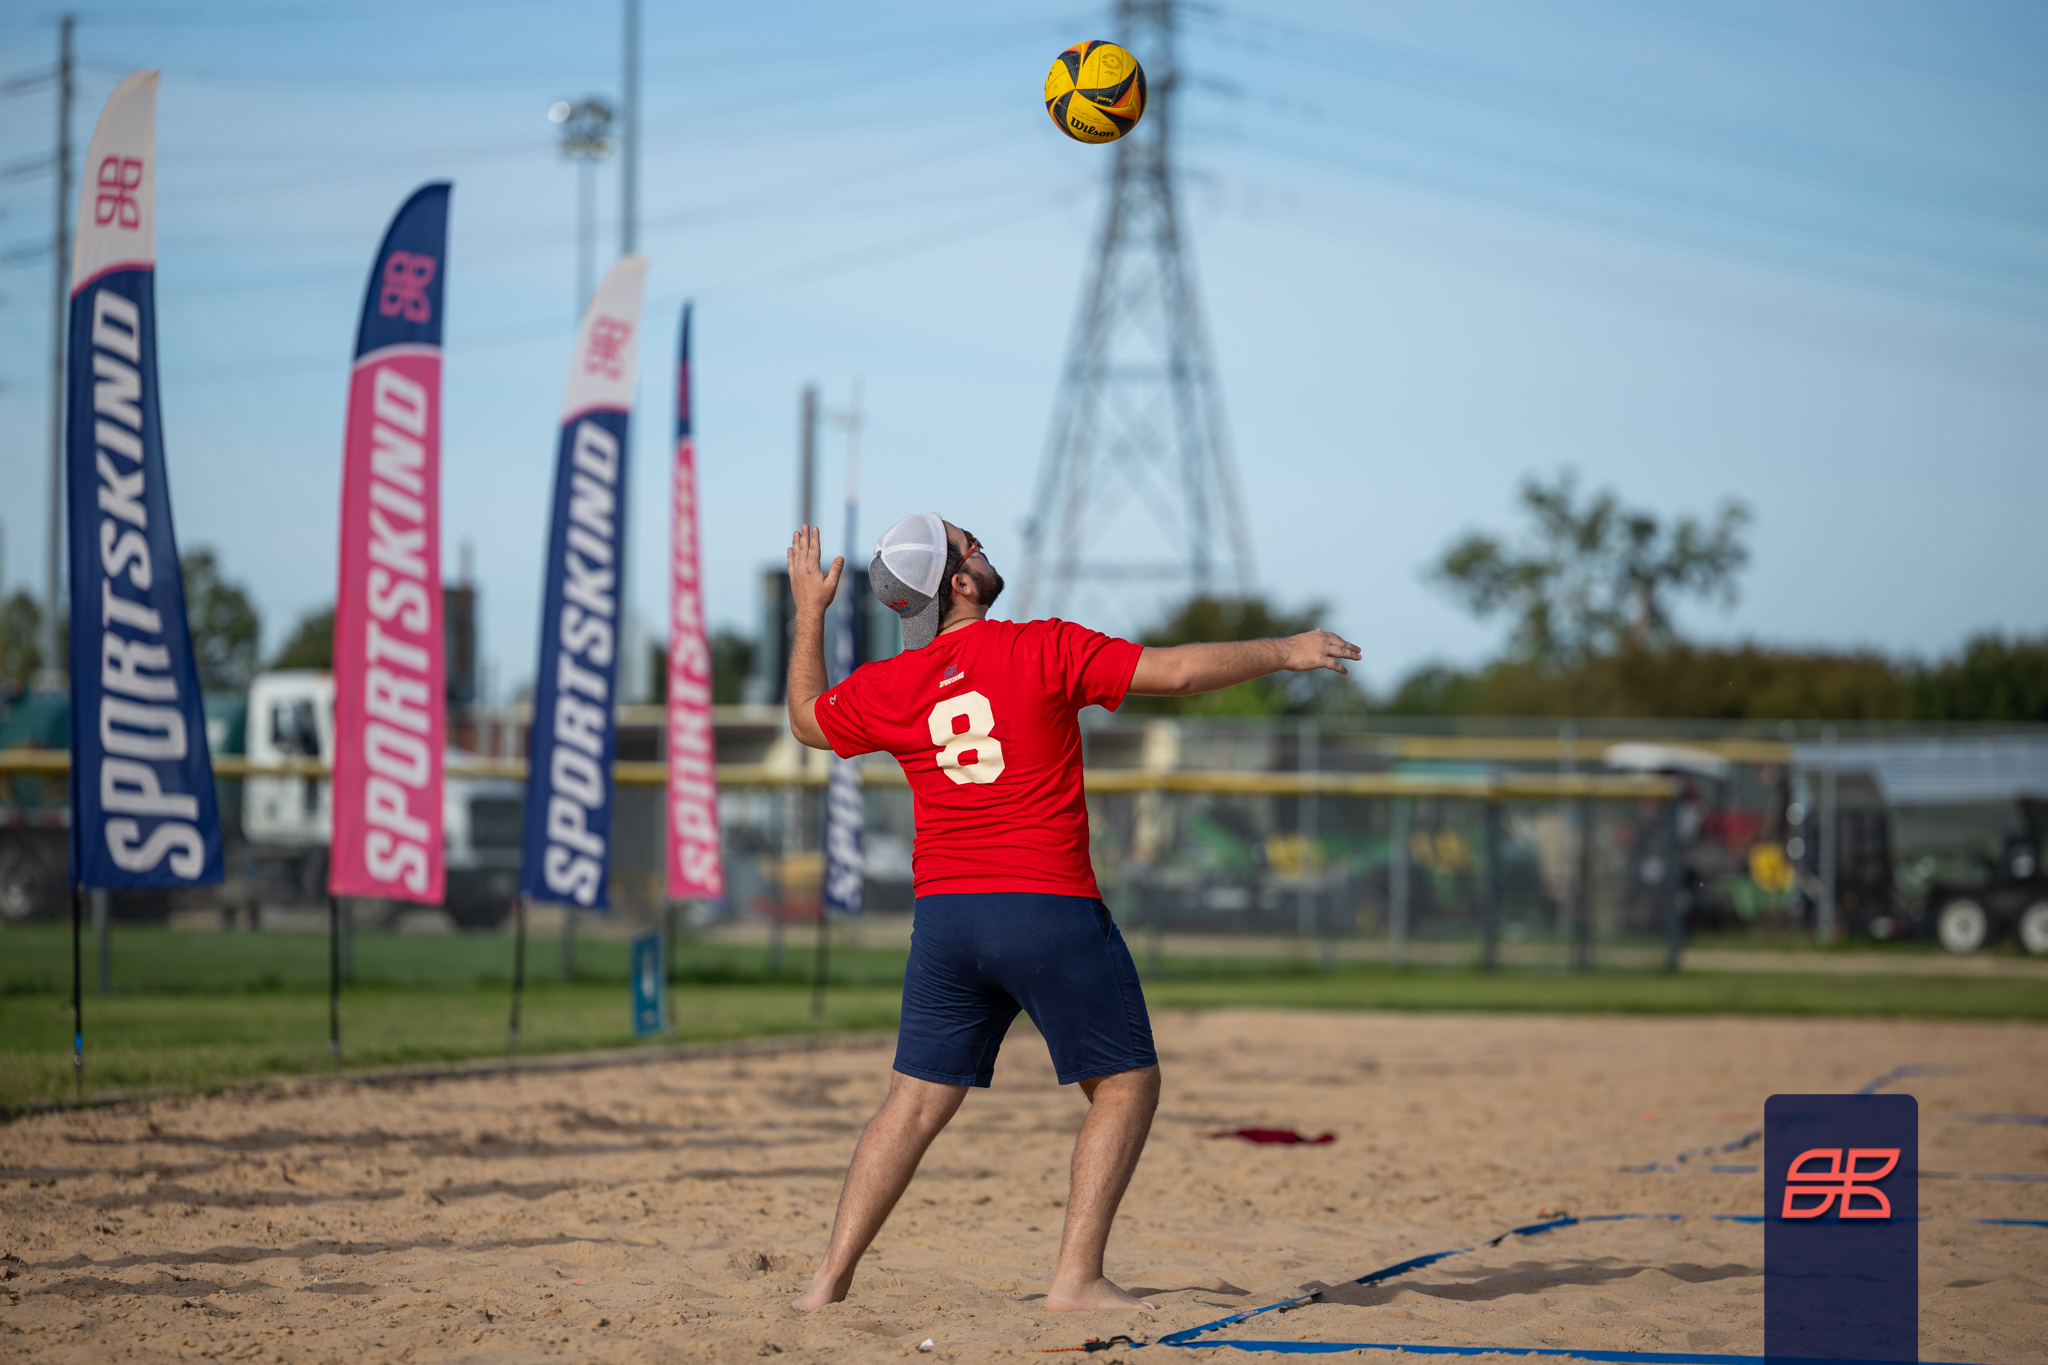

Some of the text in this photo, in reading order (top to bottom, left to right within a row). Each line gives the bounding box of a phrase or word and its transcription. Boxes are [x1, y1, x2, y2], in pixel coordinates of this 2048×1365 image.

[1071, 117, 1114, 136] Wilson
[92, 288, 204, 880] SPORTSKIND
[364, 366, 431, 896] SPORTSKIND
[544, 418, 620, 906] SPORTSKIND
[928, 690, 1006, 785] 8
